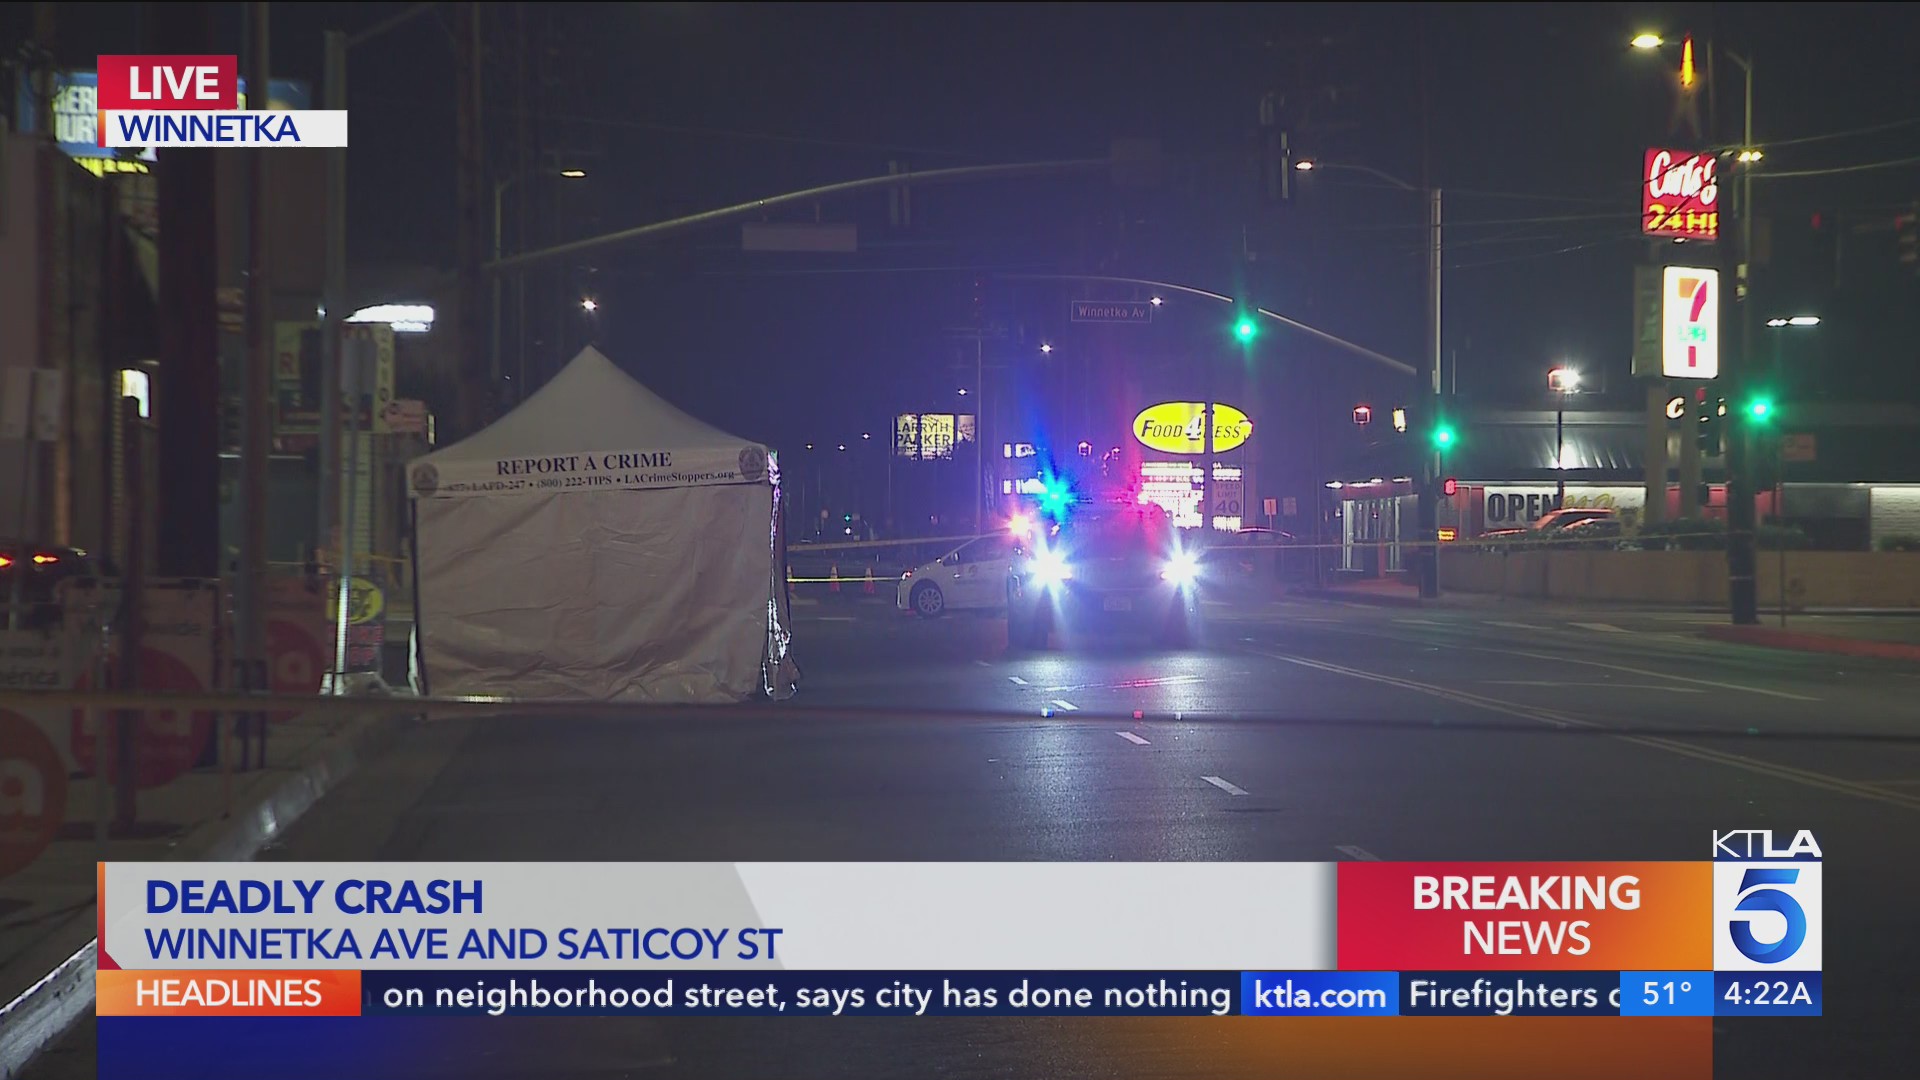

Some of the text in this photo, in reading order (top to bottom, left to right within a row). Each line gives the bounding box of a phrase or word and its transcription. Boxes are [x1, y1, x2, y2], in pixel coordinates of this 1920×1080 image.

[1078, 305, 1146, 318] Winnetka Av
[1184, 415, 1203, 441] 4
[1204, 423, 1241, 439] ESS
[496, 452, 672, 476] REPORT A CRIME
[536, 478, 562, 489] (800)
[565, 475, 612, 487] 222-TIPS
[624, 470, 735, 484] LACrimeStoppers.org
[1217, 491, 1237, 499] LIMIT
[1215, 501, 1240, 514] 40
